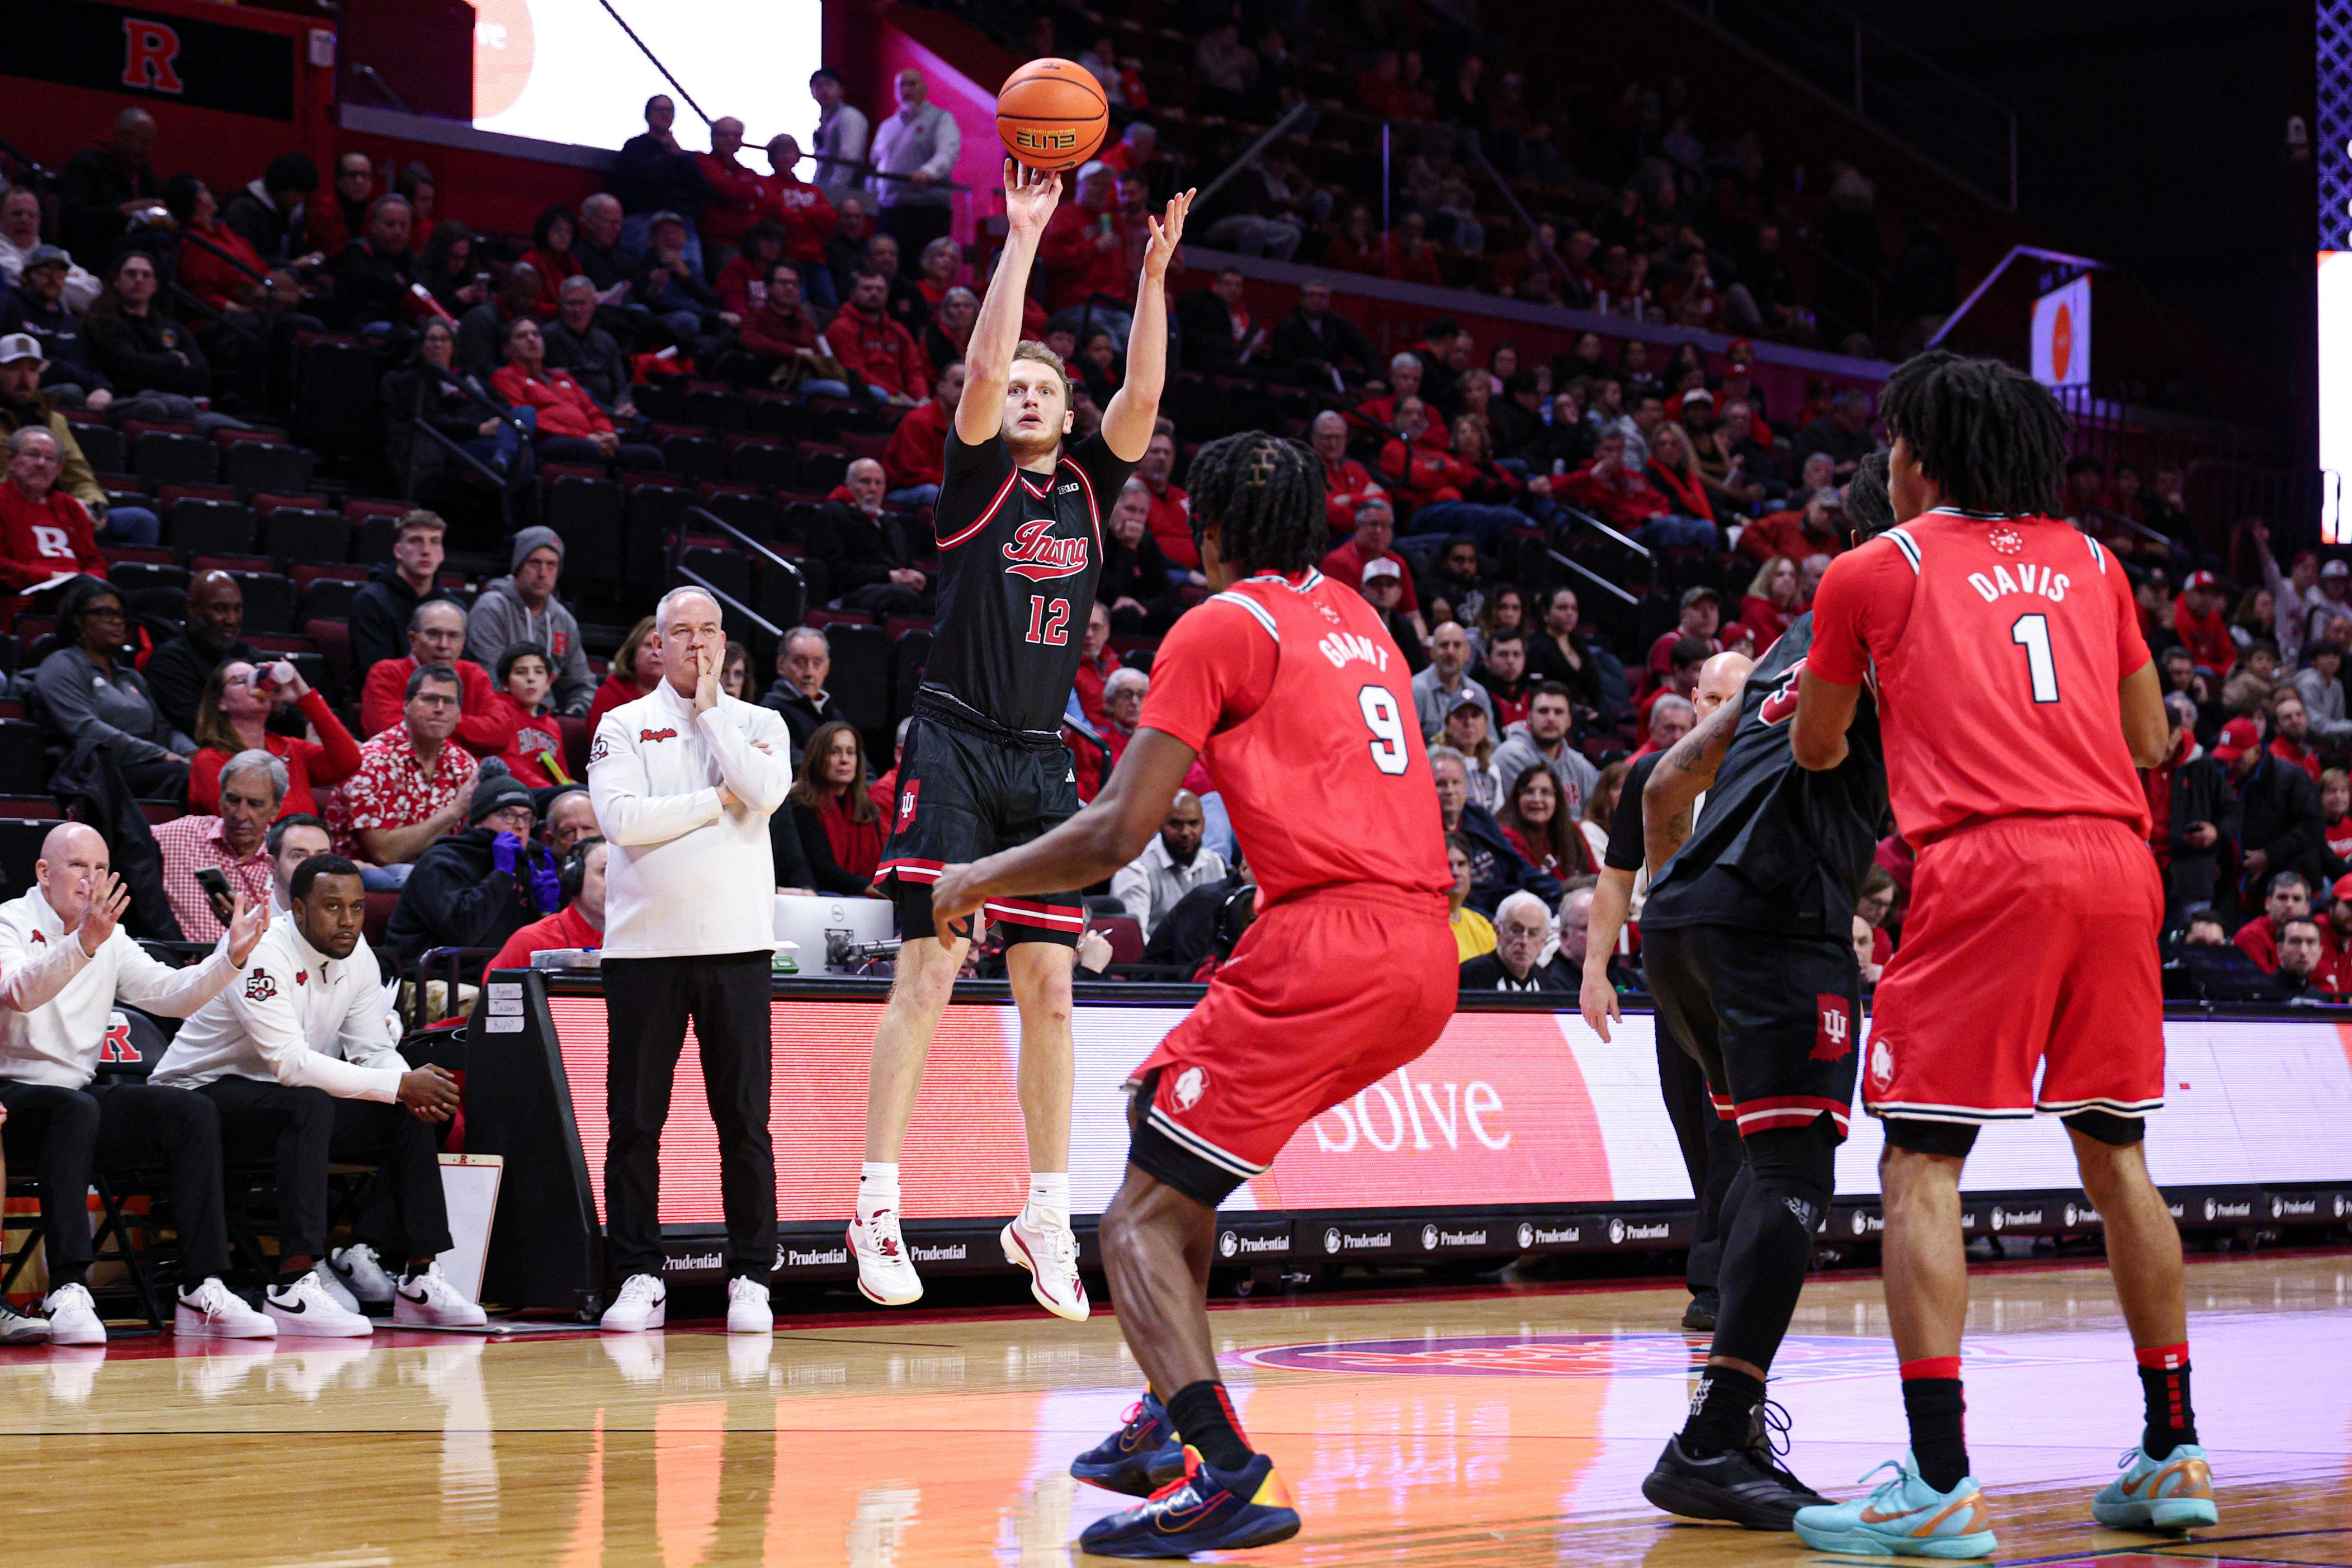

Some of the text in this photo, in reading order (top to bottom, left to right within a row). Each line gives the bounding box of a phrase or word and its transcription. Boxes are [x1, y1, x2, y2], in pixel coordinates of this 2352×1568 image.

[121, 17, 183, 94] R
[1017, 130, 1076, 150] ELITE
[31, 525, 75, 559] R
[1967, 563, 2070, 603] DAVIS
[1025, 594, 1070, 646] 12
[1319, 632, 1388, 672] GRANT
[2011, 613, 2060, 702] 1
[1357, 684, 1409, 776] 9
[247, 976, 275, 993] 50
[1344, 1232, 1391, 1249] Prudential
[1441, 1230, 1486, 1246] Prudential
[1536, 1227, 1579, 1244] Prudential
[1627, 1223, 1669, 1240] Prudential
[911, 1244, 966, 1261] Prudential
[1240, 1236, 1290, 1253] Prudential
[788, 1248, 847, 1266] Prudential
